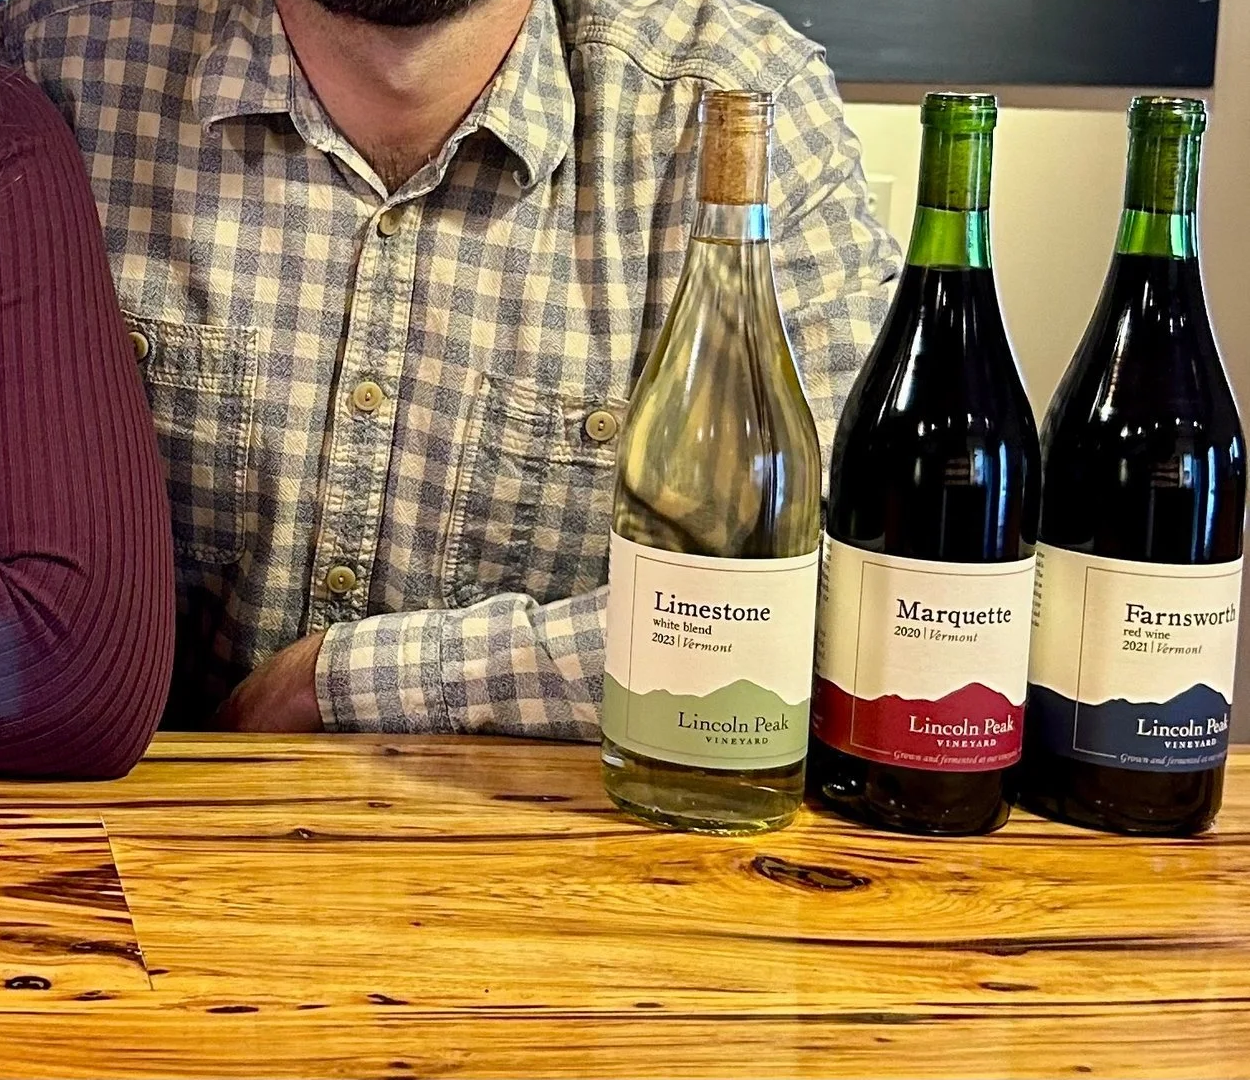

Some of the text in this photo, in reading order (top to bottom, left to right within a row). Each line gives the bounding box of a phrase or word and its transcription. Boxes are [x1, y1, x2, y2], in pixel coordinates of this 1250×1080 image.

[654, 591, 771, 621] Limestone
[896, 599, 1012, 628] Marquette
[1124, 602, 1236, 627] Farnsworth
[653, 617, 712, 636] white blend
[894, 626, 979, 643] 2020 Vermont
[1124, 628, 1171, 640] red wine
[652, 632, 733, 653] 2023 Vermont
[1122, 640, 1203, 655] 2021 Vermont
[678, 712, 789, 733] Lincoln Peak
[909, 714, 1014, 736] Lincoln Peak
[1137, 713, 1228, 737] Lincoln Peak
[706, 736, 769, 745] VINEYARD
[937, 739, 997, 748] VINEYARD
[1165, 738, 1217, 749] VINEYARD
